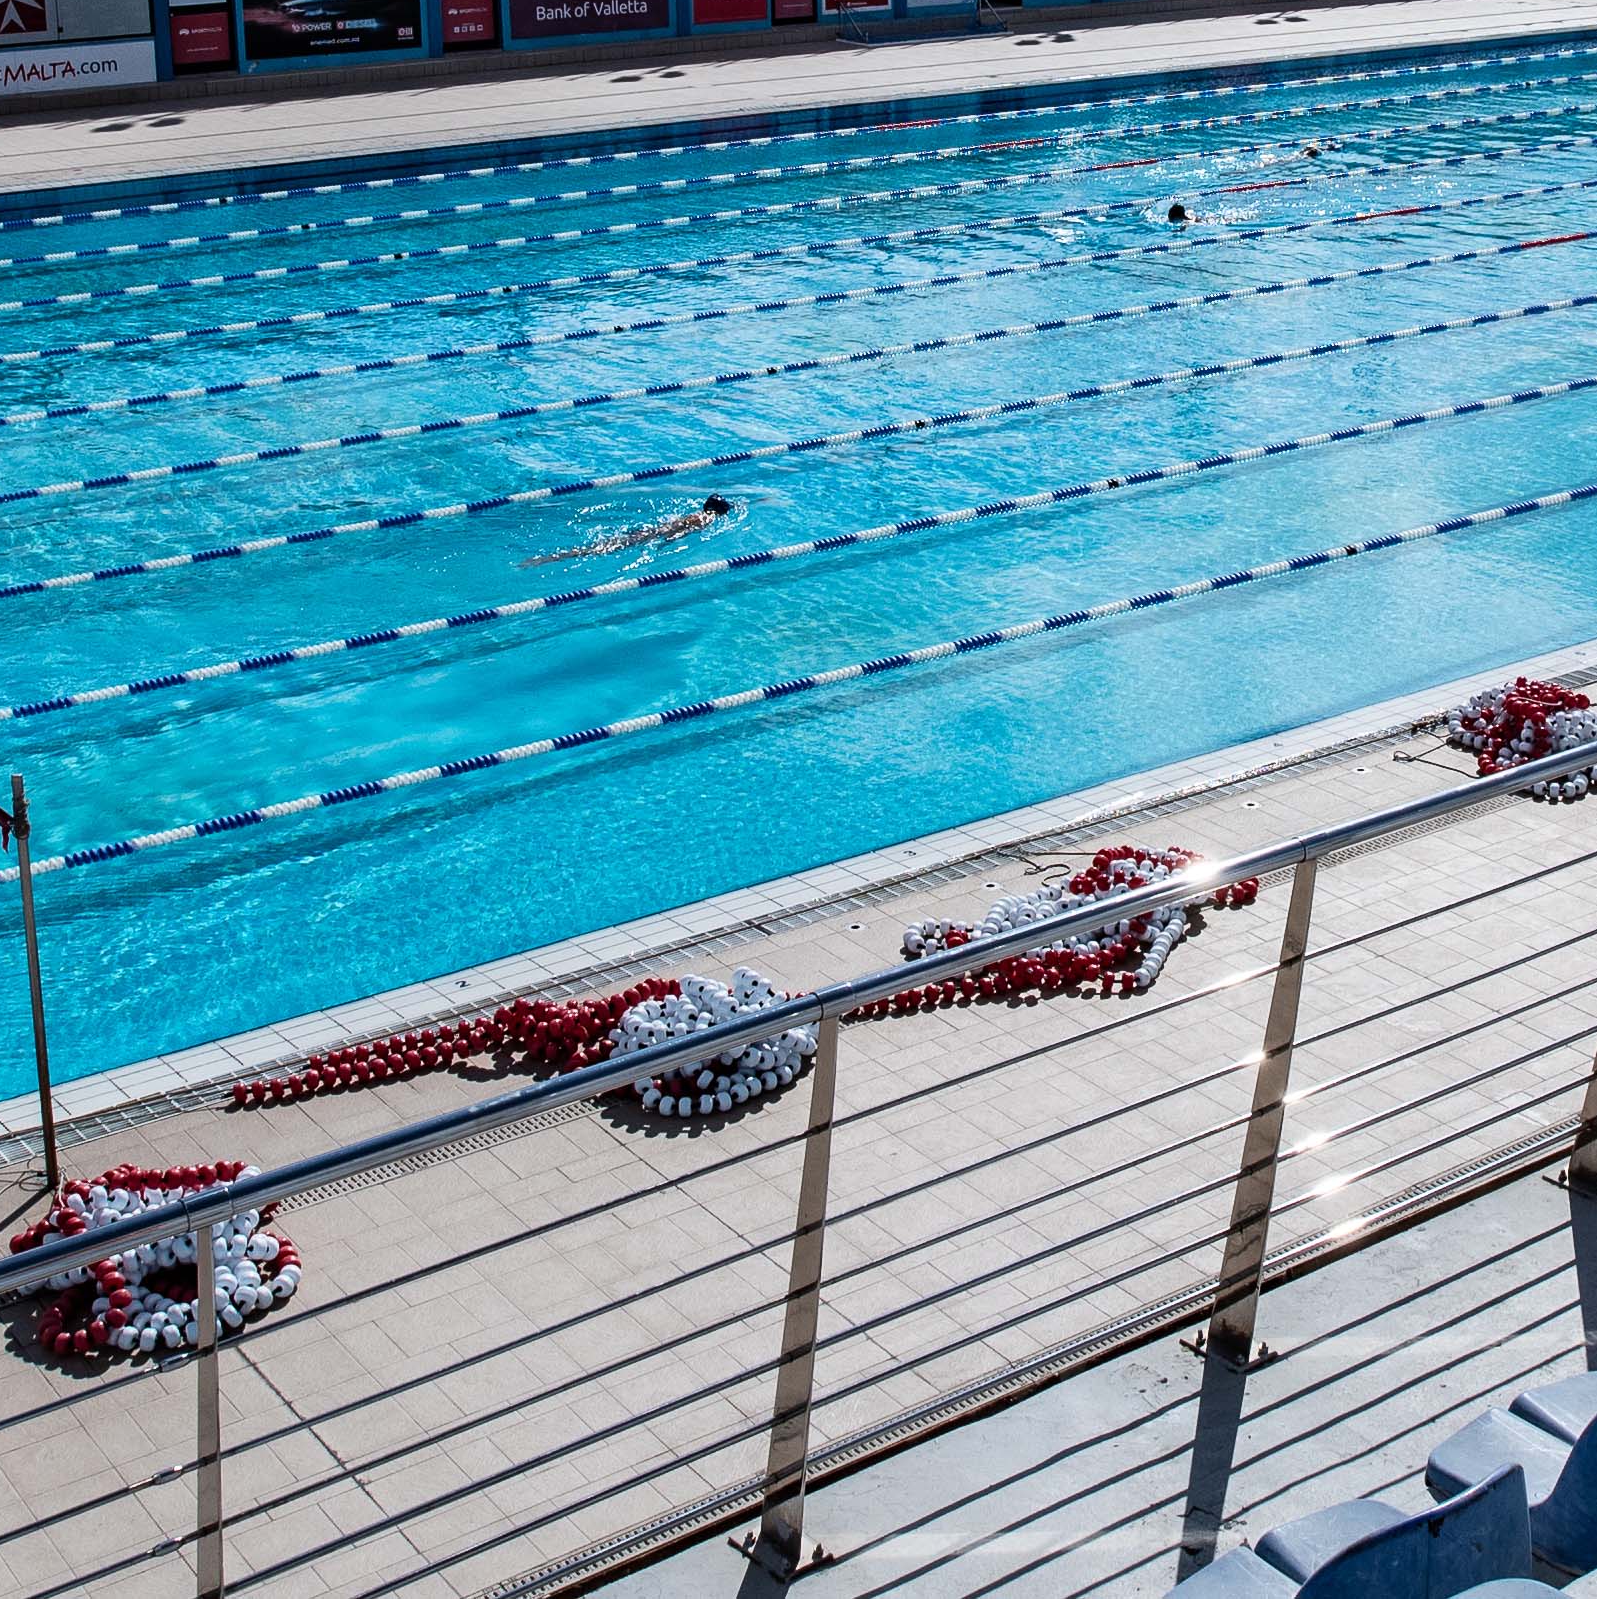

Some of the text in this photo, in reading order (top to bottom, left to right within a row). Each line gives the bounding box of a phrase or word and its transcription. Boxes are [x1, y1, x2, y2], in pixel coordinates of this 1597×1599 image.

[536, 0, 648, 21] Bank of Valletta
[302, 22, 332, 34] POWER
